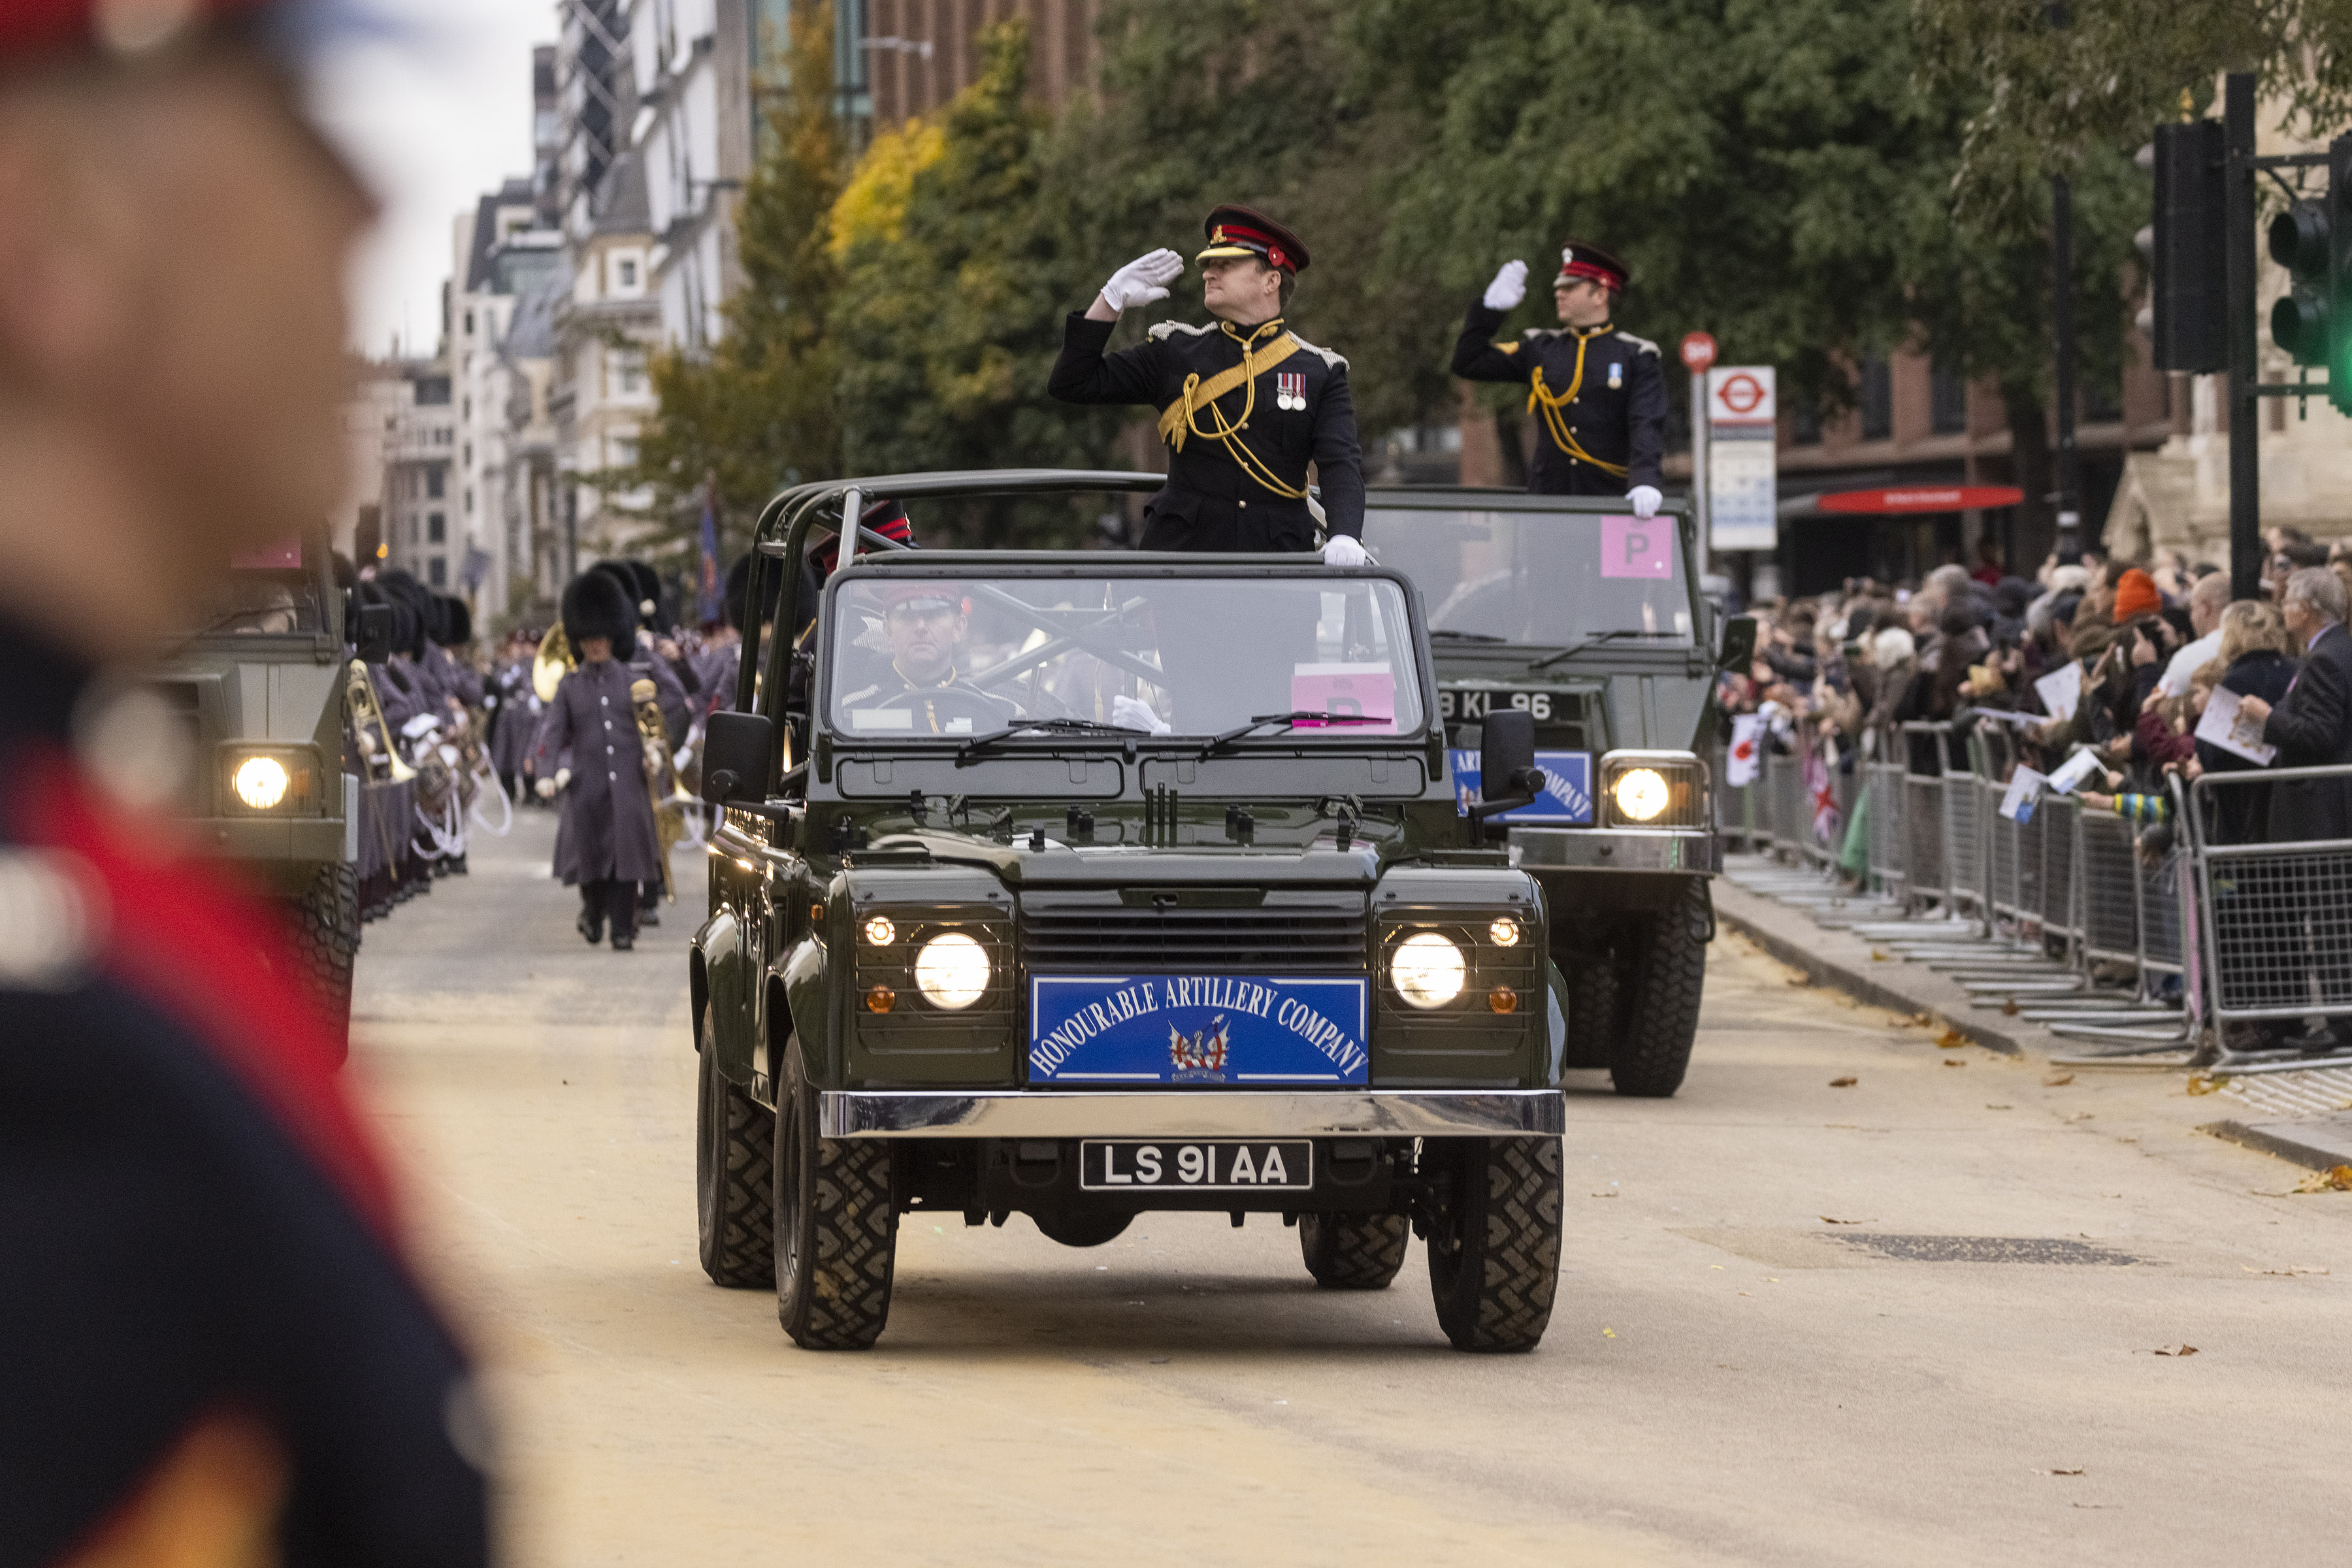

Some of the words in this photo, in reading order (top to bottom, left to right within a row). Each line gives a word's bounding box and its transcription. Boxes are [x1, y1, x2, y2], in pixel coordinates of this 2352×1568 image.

[1625, 533, 1649, 564] P
[1511, 693, 1551, 720] 96
[1029, 981, 1159, 1078] HONOURABLE
[1165, 976, 1279, 1019] ARTILLERY
[1278, 997, 1369, 1077] COMPANY
[1105, 1145, 1163, 1184] LS
[1177, 1145, 1216, 1184] 91
[1230, 1145, 1288, 1184] AA
